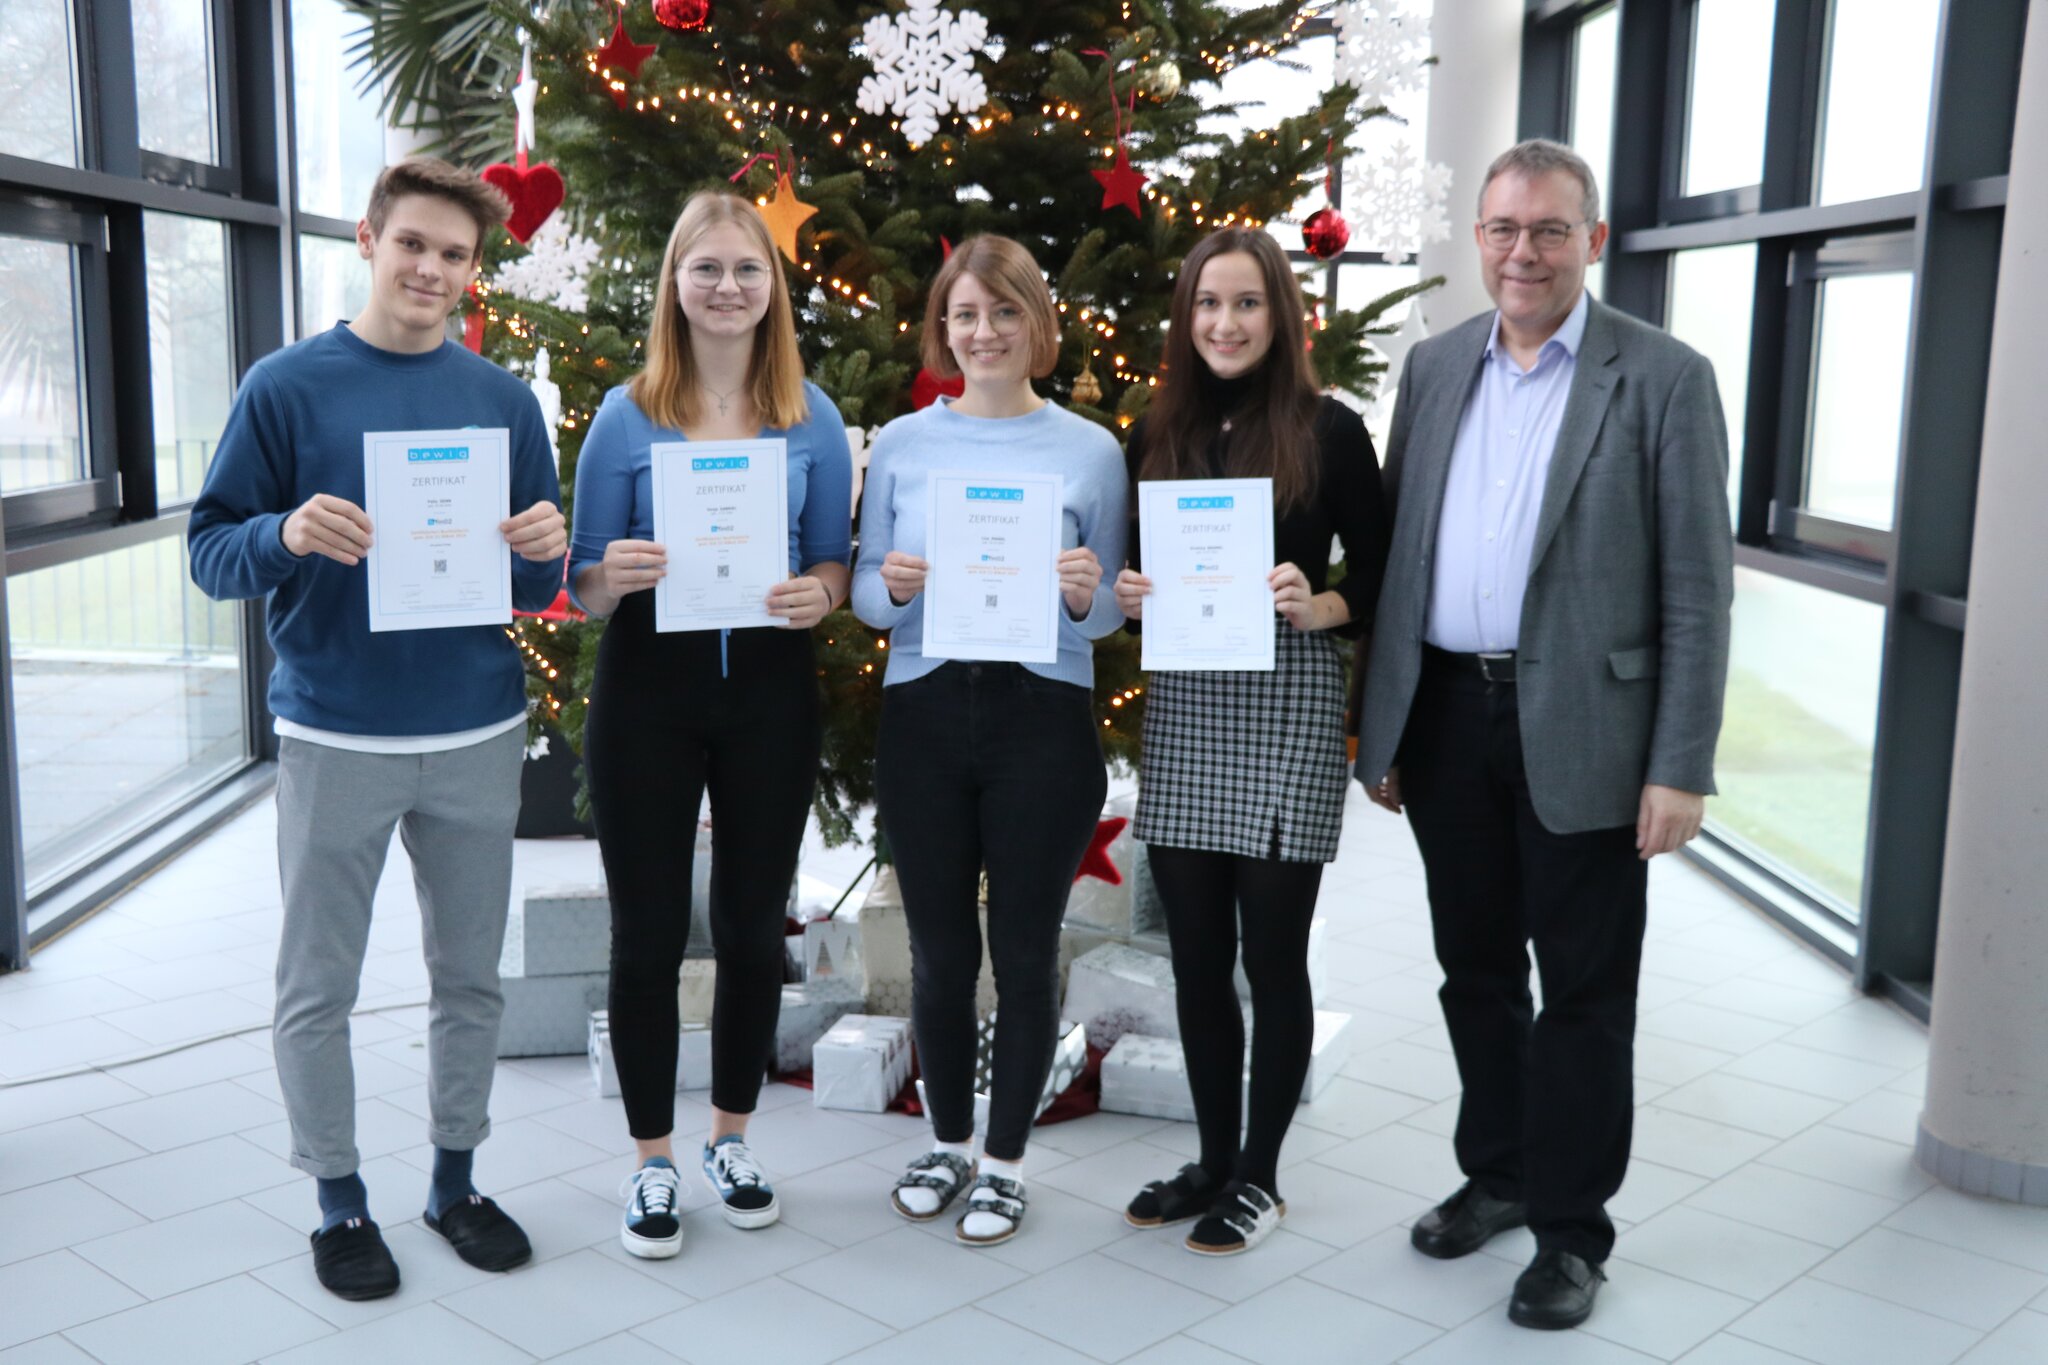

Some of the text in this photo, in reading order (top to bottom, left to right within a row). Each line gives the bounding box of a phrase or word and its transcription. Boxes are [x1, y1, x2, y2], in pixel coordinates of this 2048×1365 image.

[409, 449, 468, 460] bewig
[411, 475, 467, 487] ZERTIFIKAT
[695, 484, 747, 495] ZERTIFIKAT
[968, 514, 1020, 525] ZERTIFIKAT
[1181, 524, 1232, 534] ZERTIFIKAT
